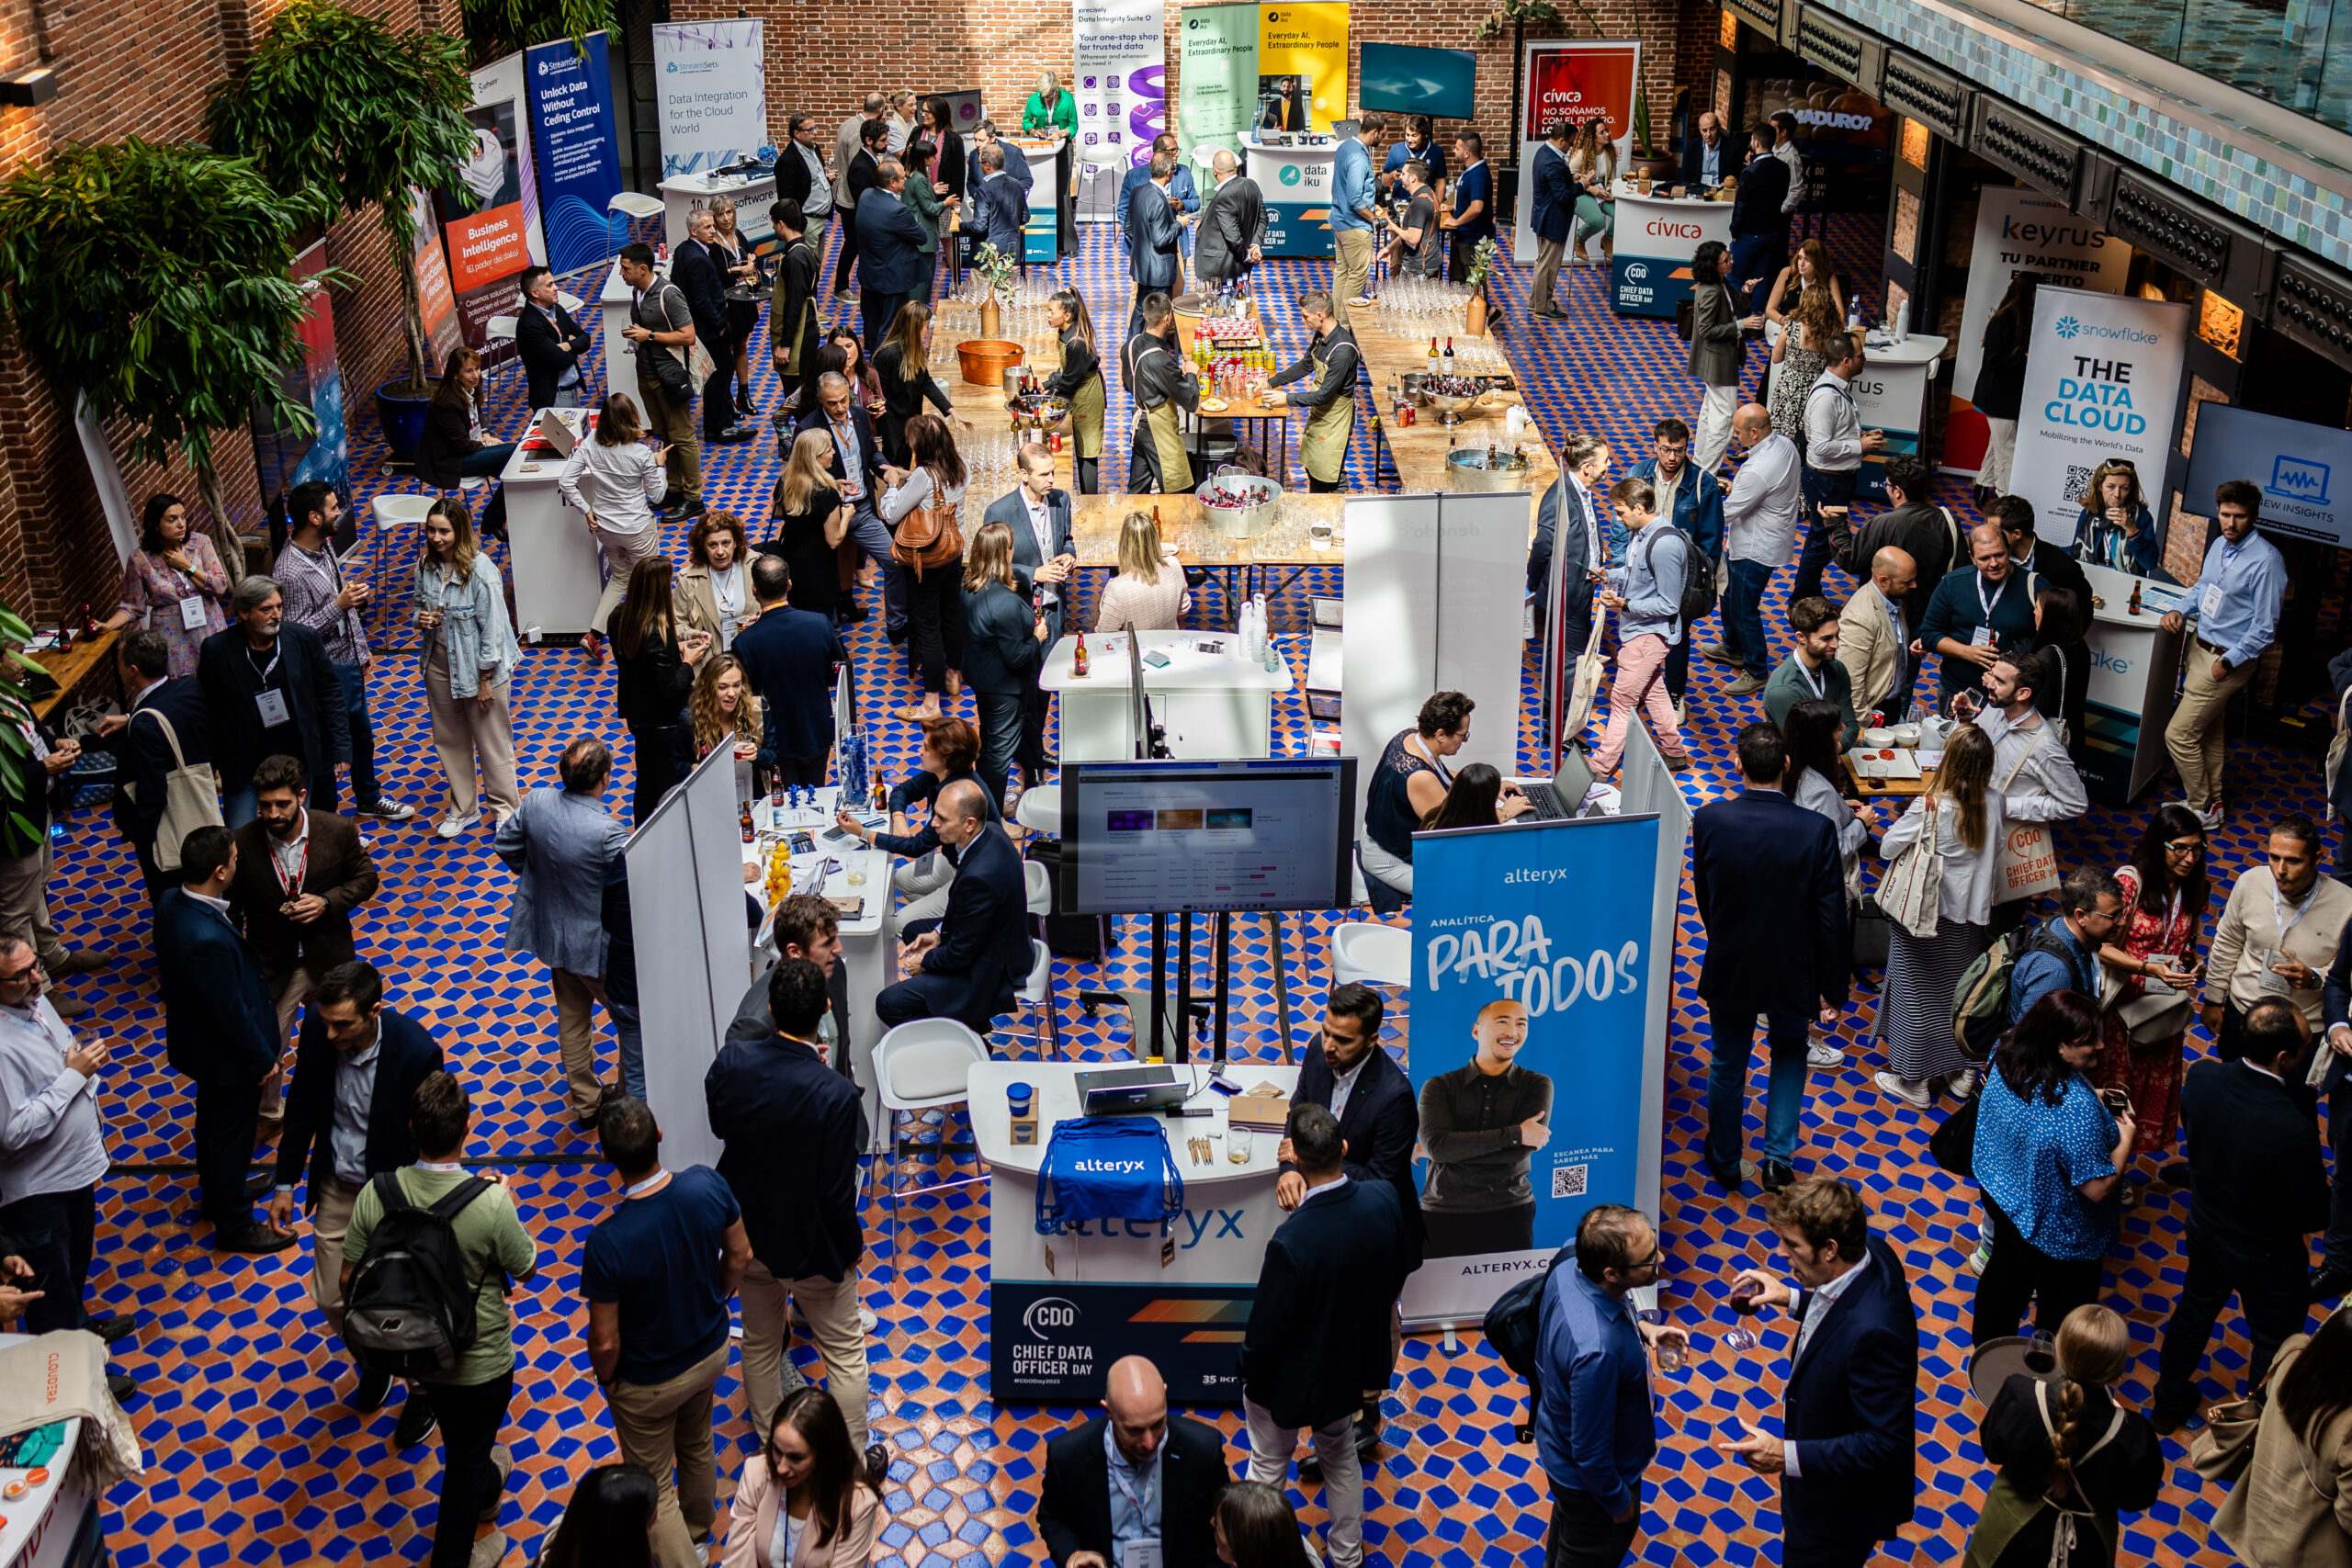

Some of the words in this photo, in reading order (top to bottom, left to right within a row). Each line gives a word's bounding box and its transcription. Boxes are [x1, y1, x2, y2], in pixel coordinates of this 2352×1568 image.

[1096, 16, 1125, 24] Integrity
[1080, 33, 1097, 41] Your
[1099, 33, 1136, 42] one-stop
[1138, 32, 1159, 42] shop
[1188, 39, 1217, 47] Everyday
[1218, 37, 1227, 45] AI,
[1092, 42, 1122, 51] trusted
[1188, 47, 1231, 57] Extraordinary
[1232, 44, 1253, 53] People
[1268, 41, 1315, 50] Extraordinary
[679, 62, 719, 70] StreamSets
[540, 85, 568, 99] Unlock
[569, 81, 588, 93] Data
[669, 95, 692, 105] Data
[695, 90, 748, 103] Integration
[1544, 88, 1582, 103] cívica
[542, 97, 575, 113] Without
[670, 109, 684, 119] for
[686, 108, 702, 118] the
[705, 106, 733, 117] Cloud
[1544, 107, 1556, 116] NO
[1559, 106, 1606, 115] SOÑAMOS
[544, 113, 571, 127] Ceding
[571, 103, 600, 118] Control
[1577, 116, 1615, 124] FUTRO.
[671, 123, 700, 135] World
[1305, 165, 1327, 175] data
[1305, 177, 1319, 186] iku
[734, 190, 774, 209] software
[468, 219, 508, 240] Business
[1646, 217, 1702, 239] cívica
[2002, 215, 2105, 249] keyrus
[462, 232, 518, 258] Intelligence
[466, 265, 475, 274] (El
[475, 258, 493, 273] poder
[493, 254, 503, 264] del
[503, 249, 519, 260] dato)
[2000, 252, 2021, 265] TU
[2025, 254, 2101, 273] PARTNER
[1631, 267, 1646, 278] CDO
[465, 294, 490, 307] Creamos
[490, 286, 515, 299] soluciones
[1620, 286, 1637, 294] CHIEF
[1638, 287, 1653, 296] DATA
[1620, 293, 1643, 302] OFFICER
[467, 303, 493, 319] potencien
[474, 314, 489, 324] datos
[2082, 324, 2158, 344] snowflake
[2074, 355, 2132, 384] THE
[2058, 378, 2132, 410] DATA
[2044, 400, 2146, 434] CLOUD
[2040, 430, 2078, 444] Mobilizing
[2079, 436, 2093, 446] the
[2094, 439, 2123, 450] World's
[2125, 444, 2143, 454] Data
[2283, 503, 2334, 523] INSIGHTS
[2016, 829, 2041, 848] CDO
[1504, 868, 1567, 884] alteryx
[2006, 861, 2034, 877] CHIEF
[2008, 870, 2046, 888] OFFICER
[2048, 867, 2058, 878] DA
[1430, 915, 1496, 928] ANALÍTICA
[1427, 914, 1553, 992] PARA
[1495, 940, 1639, 1018] TODOS
[1554, 1148, 1590, 1158] ESCANEA
[1554, 1156, 1579, 1165] SABER
[1074, 1158, 1145, 1174] alteryx
[1461, 1258, 1552, 1276] ALTERYX.C
[1037, 1306, 1074, 1326] CDO
[1012, 1345, 1056, 1359] CHIEF
[1057, 1346, 1093, 1360] DATA
[1012, 1360, 1069, 1375] OFFICER
[1072, 1365, 1092, 1375] DAY
[47, 1353, 60, 1404] CLOUDERA
[1203, 1375, 1217, 1384] 35
